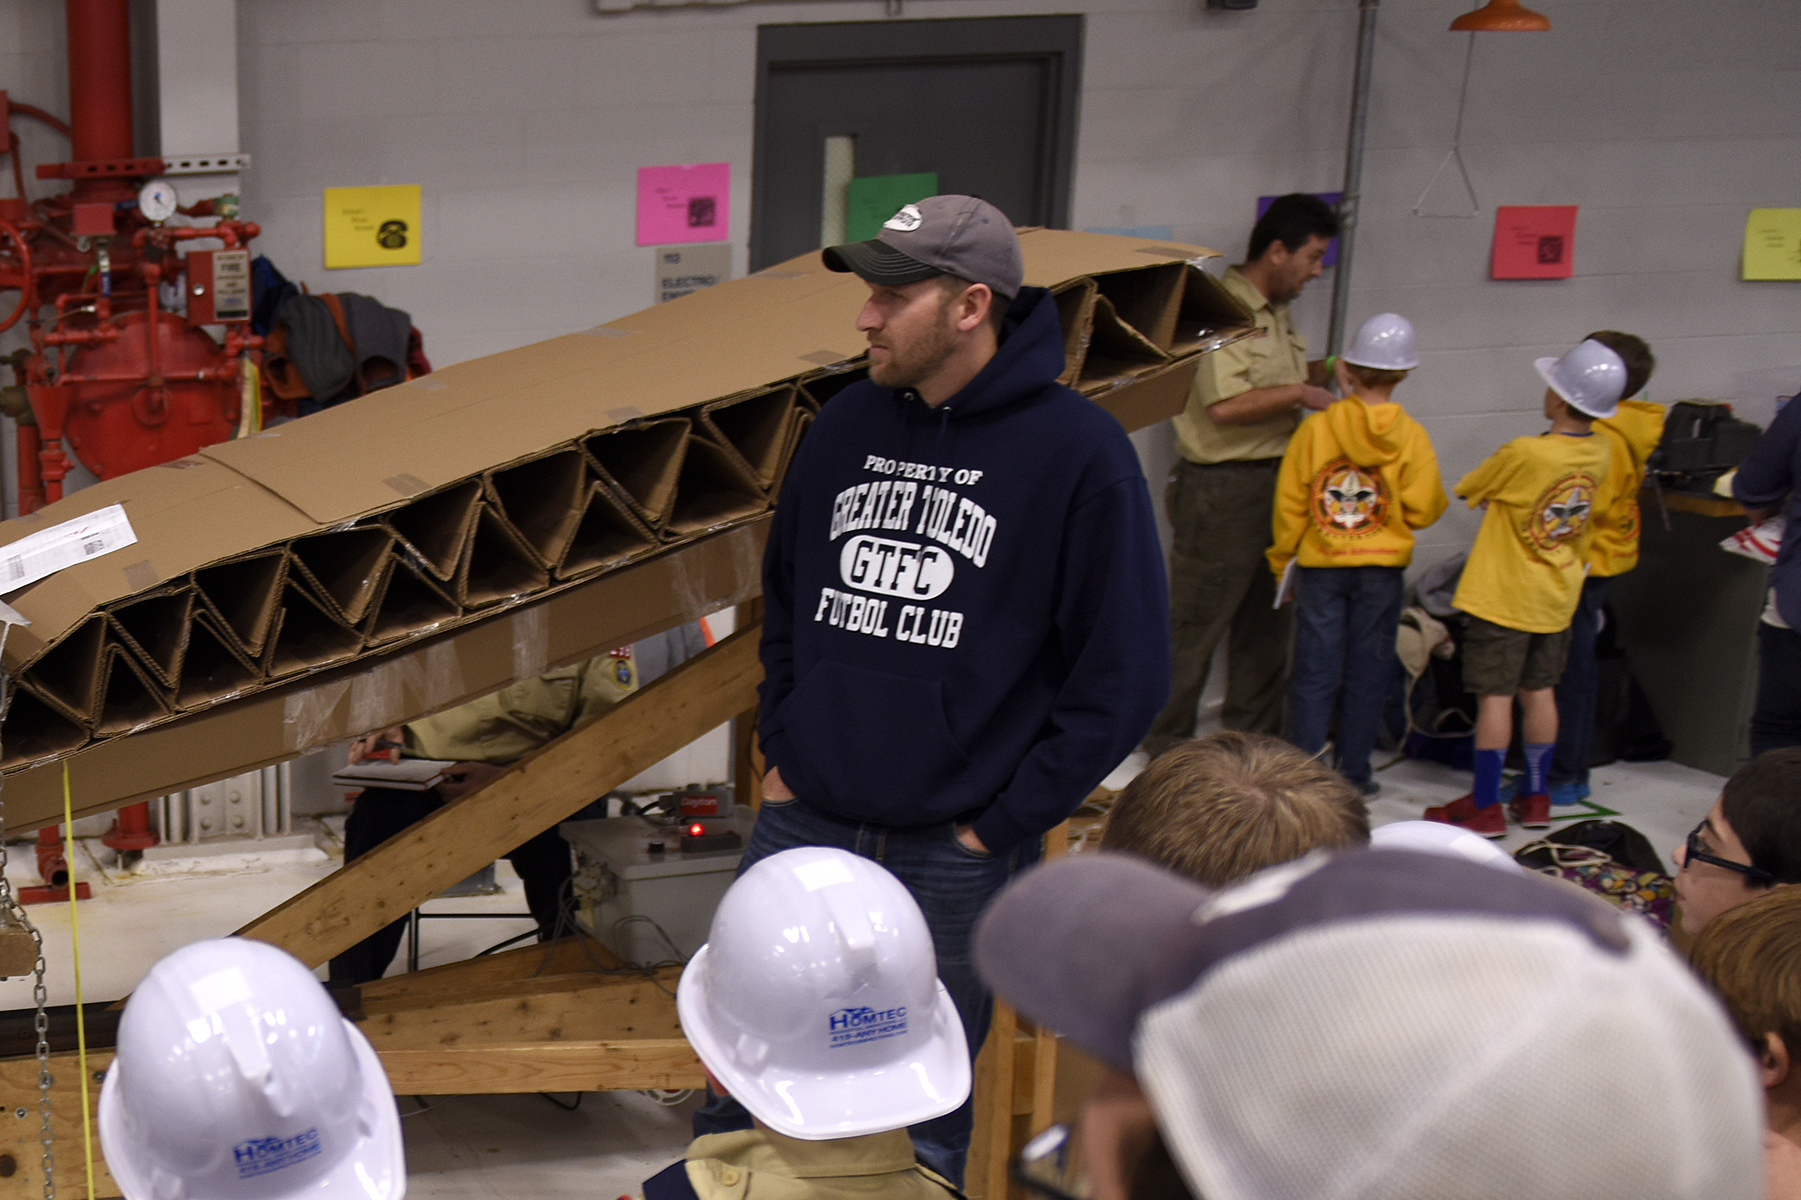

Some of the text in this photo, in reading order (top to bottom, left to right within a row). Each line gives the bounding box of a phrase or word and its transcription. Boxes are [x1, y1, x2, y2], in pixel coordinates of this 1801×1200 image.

[863, 455, 983, 485] PROPERTY OF
[829, 480, 998, 569] GREATER TOLEDO
[850, 539, 939, 596] GTFC
[814, 587, 964, 649] FUTBOL CLUB
[829, 1006, 907, 1031] HOMTEC
